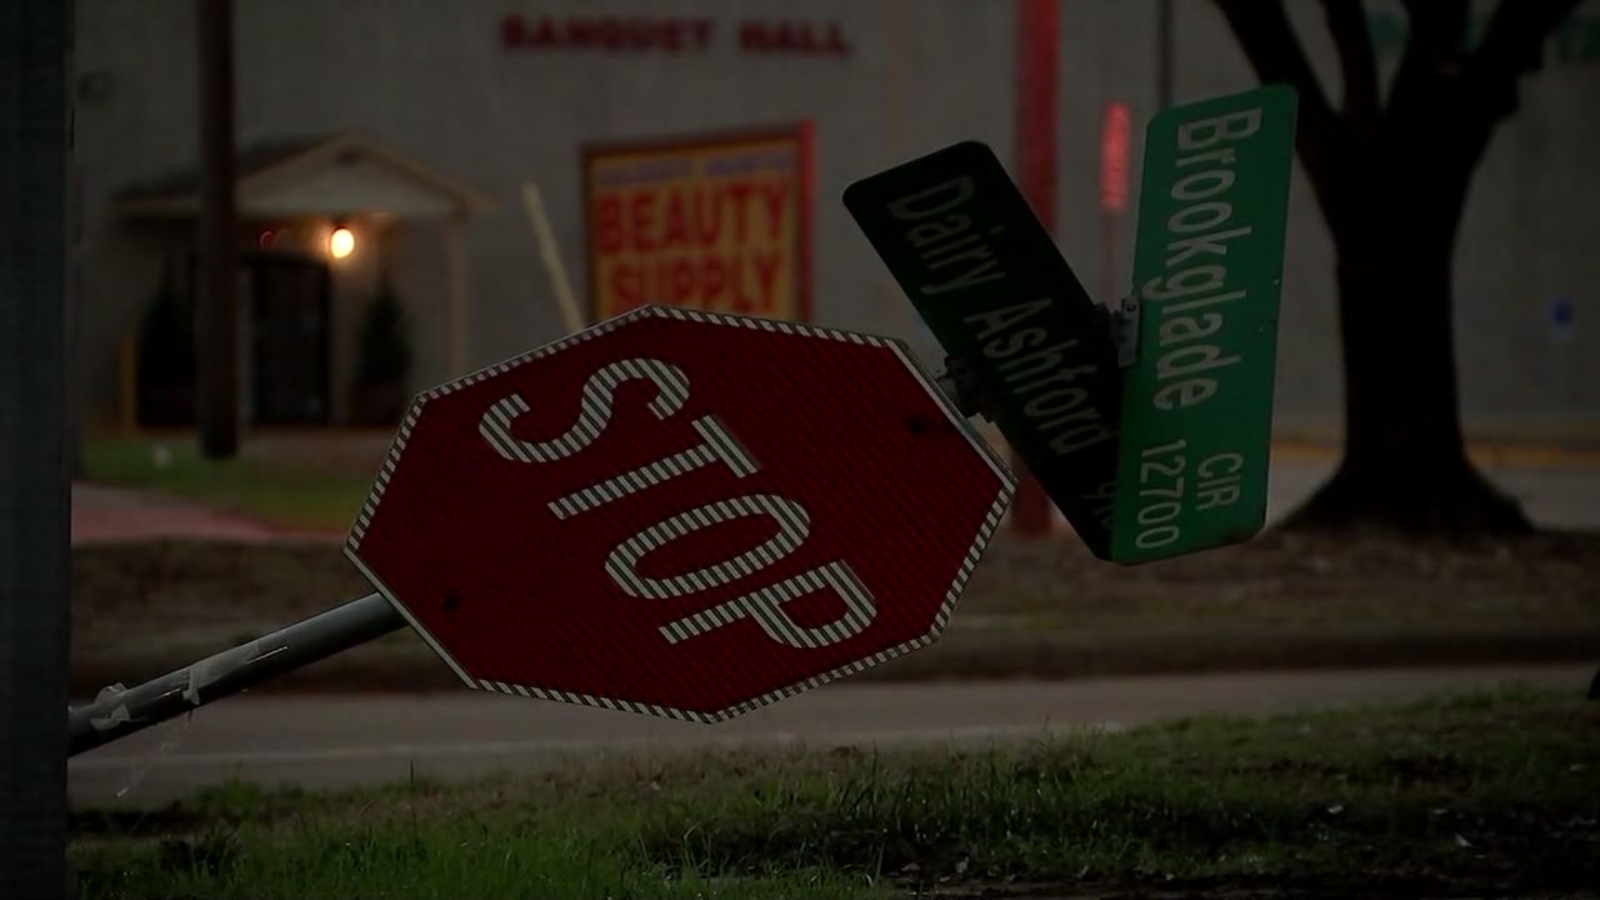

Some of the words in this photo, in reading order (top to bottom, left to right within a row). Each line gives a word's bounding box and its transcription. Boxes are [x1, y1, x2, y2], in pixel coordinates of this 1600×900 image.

[739, 18, 853, 56] HALL
[596, 178, 788, 254] BEAUTY
[1144, 107, 1263, 411] Brookglade
[609, 250, 780, 314] SUPPLY
[884, 173, 1007, 297] Dairy
[962, 297, 1121, 457] Ashford
[477, 357, 877, 650] STOP
[1135, 437, 1188, 550] 12700
[1195, 451, 1245, 511] CIR
